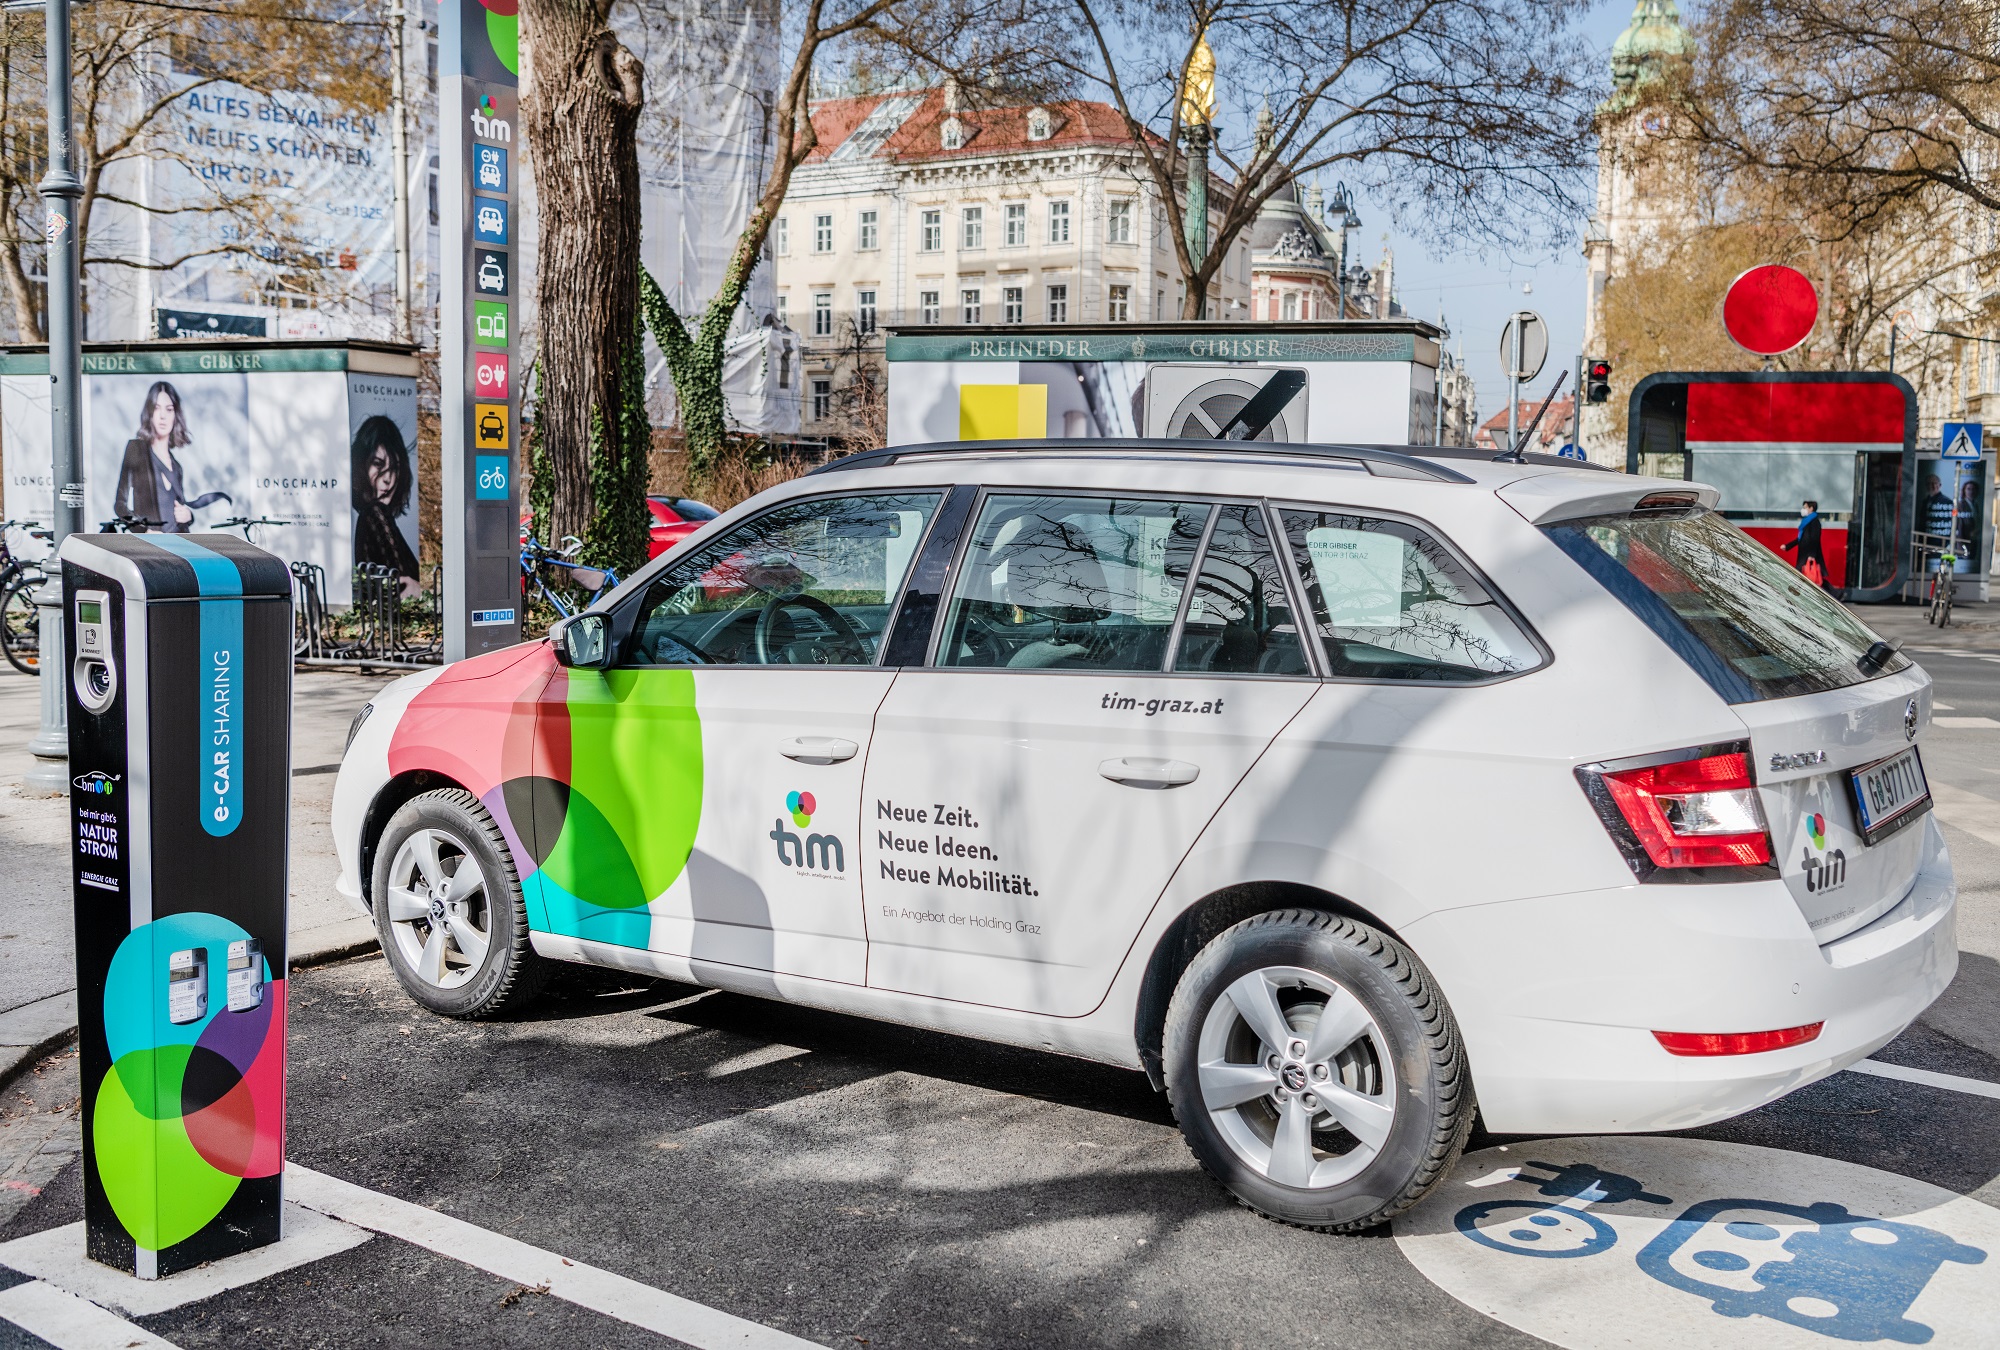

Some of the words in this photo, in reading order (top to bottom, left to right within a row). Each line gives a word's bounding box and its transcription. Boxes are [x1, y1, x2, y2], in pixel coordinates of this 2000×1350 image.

[188, 92, 250, 118] ALTES
[470, 107, 511, 143] tim
[188, 125, 259, 153] NEUES
[353, 205, 383, 220] 1825
[969, 339, 1093, 357] BREINEDER
[1189, 339, 1282, 357] GIBISER
[81, 355, 137, 371] INEDER
[199, 352, 263, 370] GIBISER
[354, 383, 413, 397] LONGCHAMP
[256, 478, 338, 489] LONGCHAMP
[1324, 551, 1339, 559] TOR
[1348, 552, 1369, 560] GRAZ
[1329, 542, 1357, 550] GIBISER
[214, 650, 230, 745] SHARING
[1101, 691, 1224, 716] tim-graz.at
[214, 751, 230, 822] e-CAR
[79, 807, 89, 817] bei
[90, 810, 100, 820] mir
[101, 812, 117, 824] gibt's
[877, 798, 928, 823] Neue
[933, 803, 979, 828] Zeit.
[80, 821, 118, 844] NATUR
[878, 829, 929, 854] Neue
[935, 835, 998, 861] Ideen.
[80, 838, 118, 860] STROM
[769, 818, 845, 873] tim
[84, 871, 104, 883] ENERGIE
[104, 876, 118, 886] GRAZ
[880, 859, 931, 885] Neue
[937, 865, 1039, 897] Mobilität.
[1801, 846, 1847, 893] tim
[882, 905, 898, 918] Ein
[900, 908, 945, 924] Angebot
[948, 913, 967, 926] der
[969, 915, 1012, 933] Holding
[1015, 920, 1041, 935] Graz
